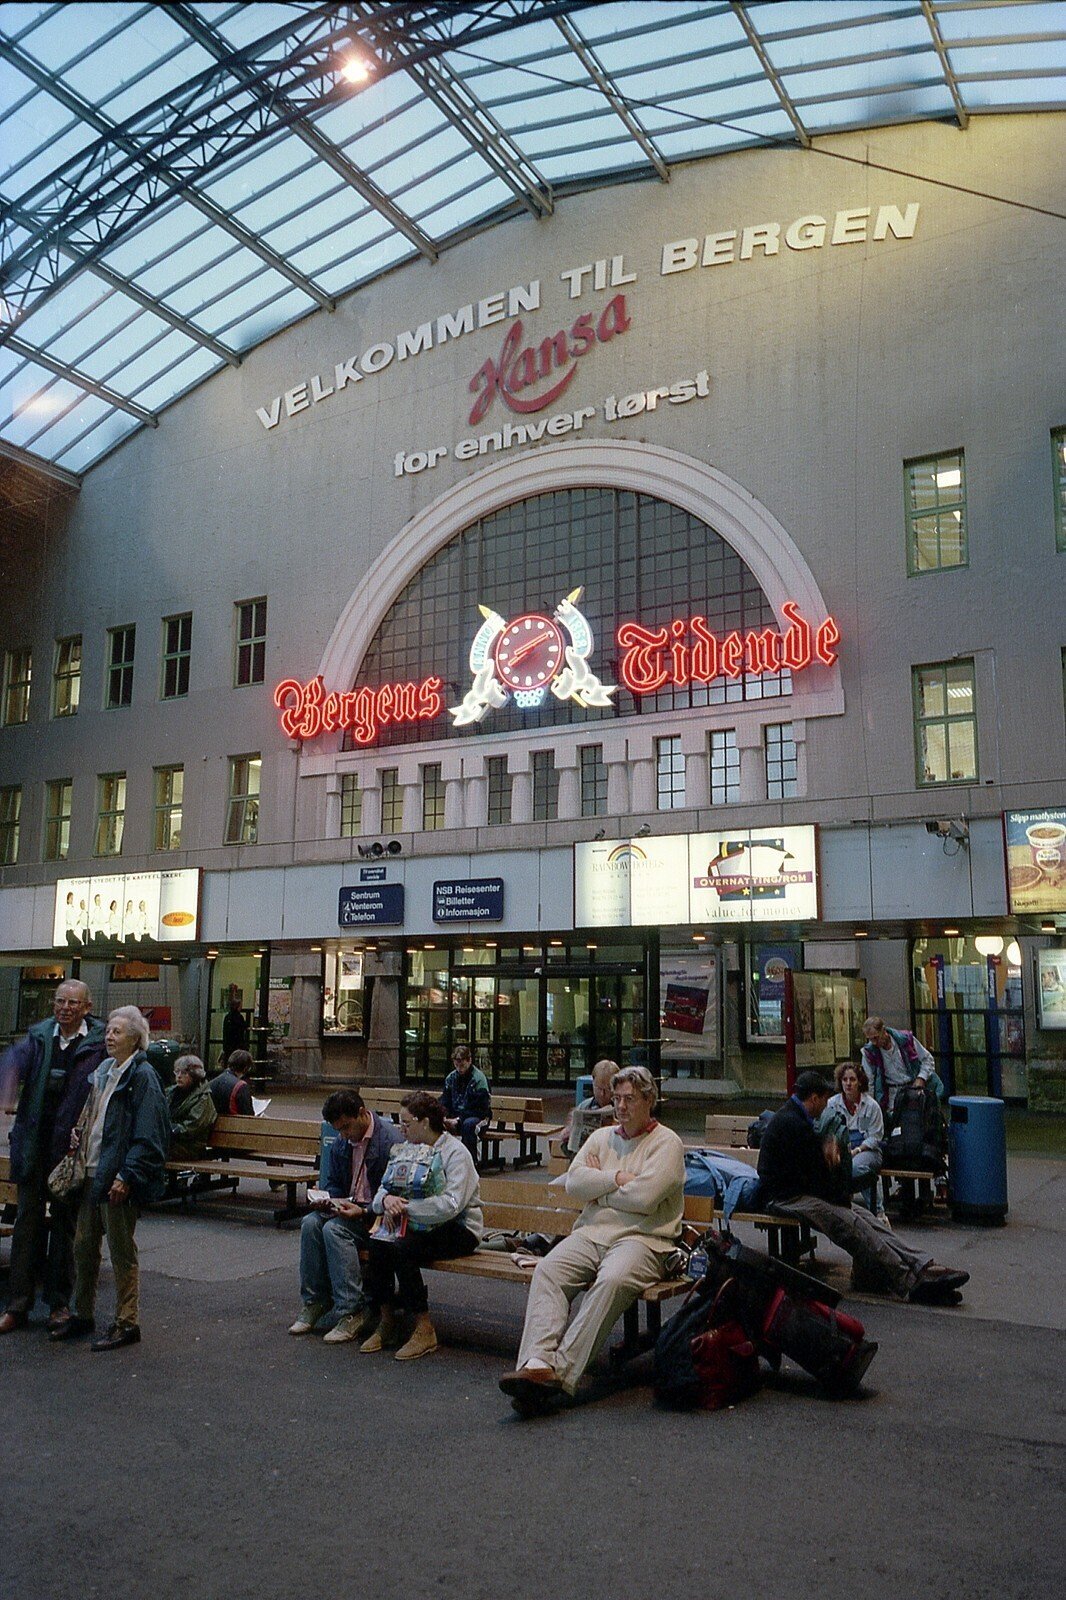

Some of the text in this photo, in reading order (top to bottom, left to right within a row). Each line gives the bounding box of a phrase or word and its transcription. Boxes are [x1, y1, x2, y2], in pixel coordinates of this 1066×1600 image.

[255, 202, 920, 430] VELKOMMEN TIL BERGEN
[468, 293, 632, 426] Hansa
[394, 369, 711, 477] for enhver tørst
[274, 600, 843, 743] Bergens Tidende
[591, 860, 665, 872] RAINBOW HOTELS
[699, 873, 808, 888] OVERNATTING/ROM
[351, 891, 381, 901] Sentrum
[436, 884, 501, 896] NSB Reisesenter
[351, 902, 384, 911] Venterom
[445, 897, 475, 906] Billetter
[350, 912, 376, 922] Telefon
[445, 907, 490, 918] Informasjon
[705, 905, 802, 918] Value for money
